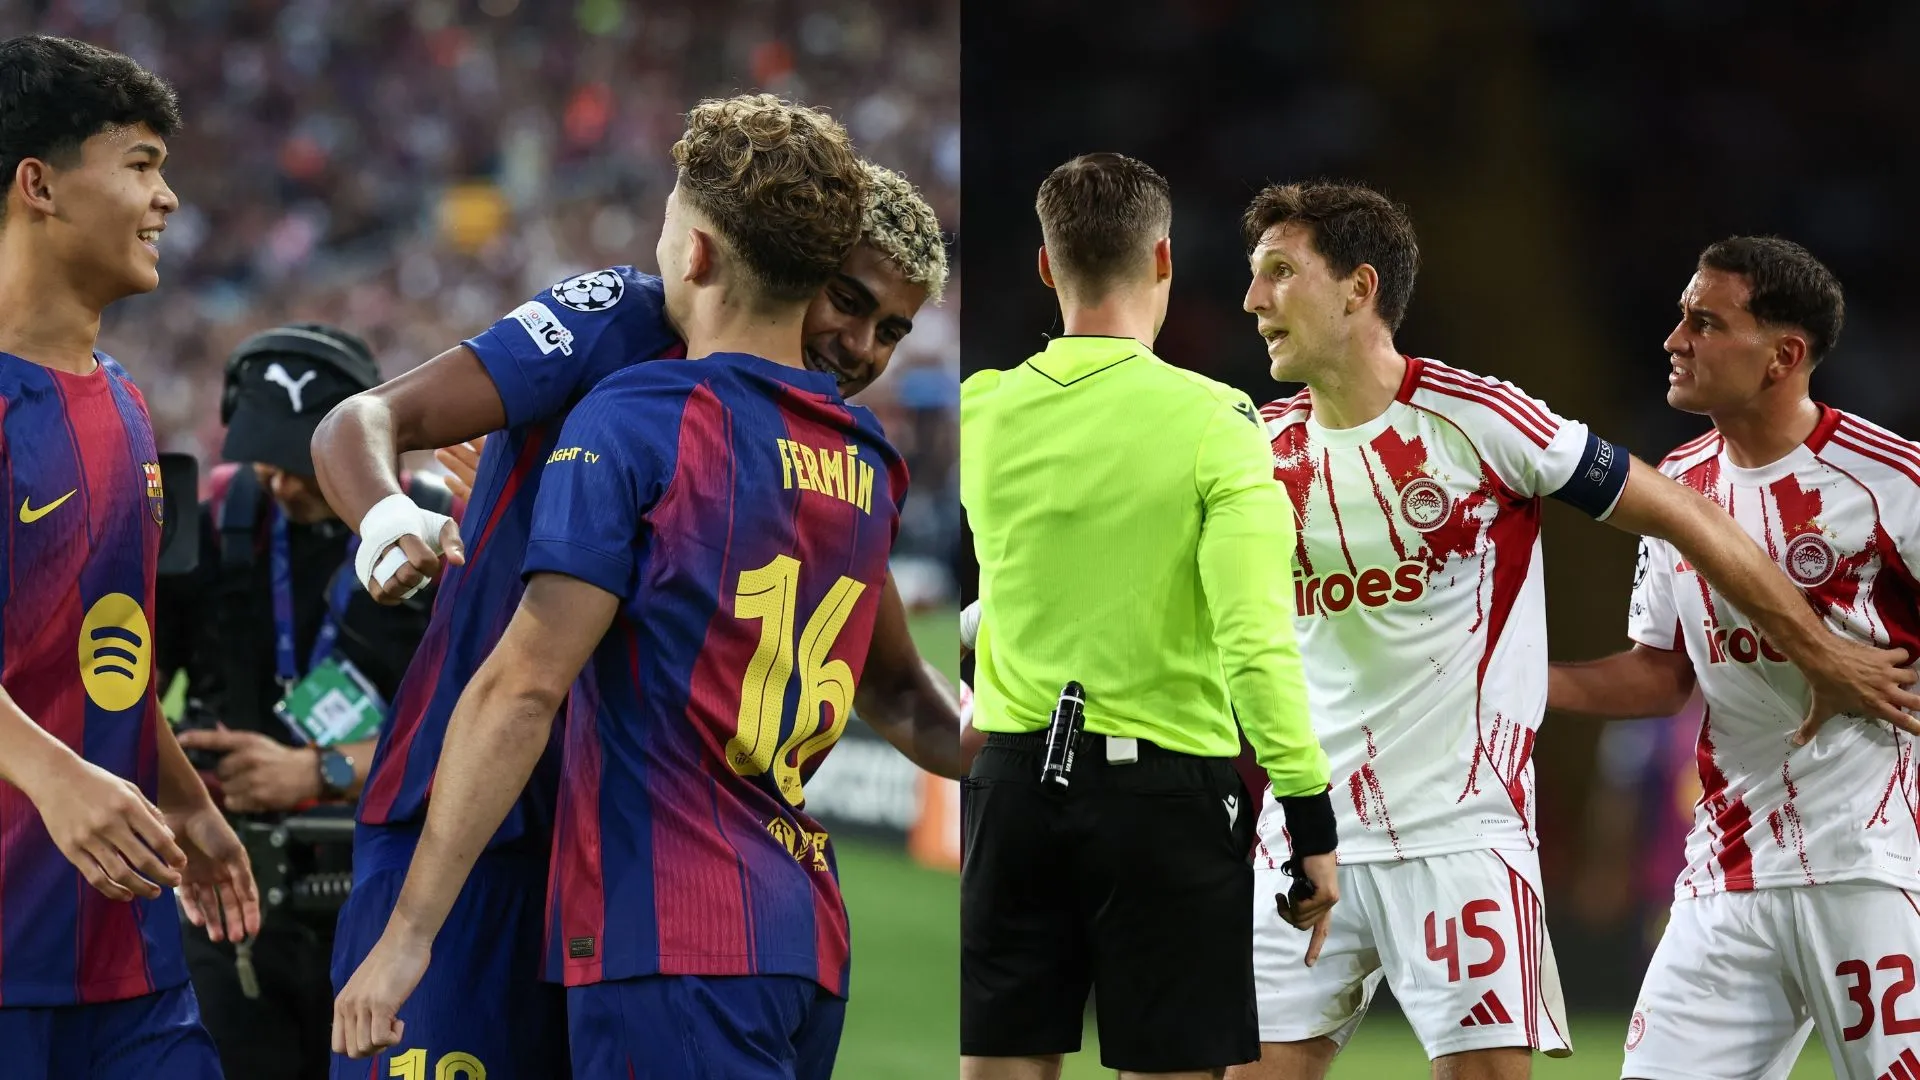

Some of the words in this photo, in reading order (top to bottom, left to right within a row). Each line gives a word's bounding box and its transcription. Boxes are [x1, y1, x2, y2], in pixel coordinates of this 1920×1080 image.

[584, 450, 600, 464] tv
[776, 438, 874, 516] FERMÍN
[1293, 564, 1424, 617] iroes
[1704, 620, 1790, 664] iro
[726, 554, 867, 807] 16
[1064, 746, 1075, 772] VANIS
[1424, 899, 1506, 983] 45
[1835, 953, 1920, 1042] 32
